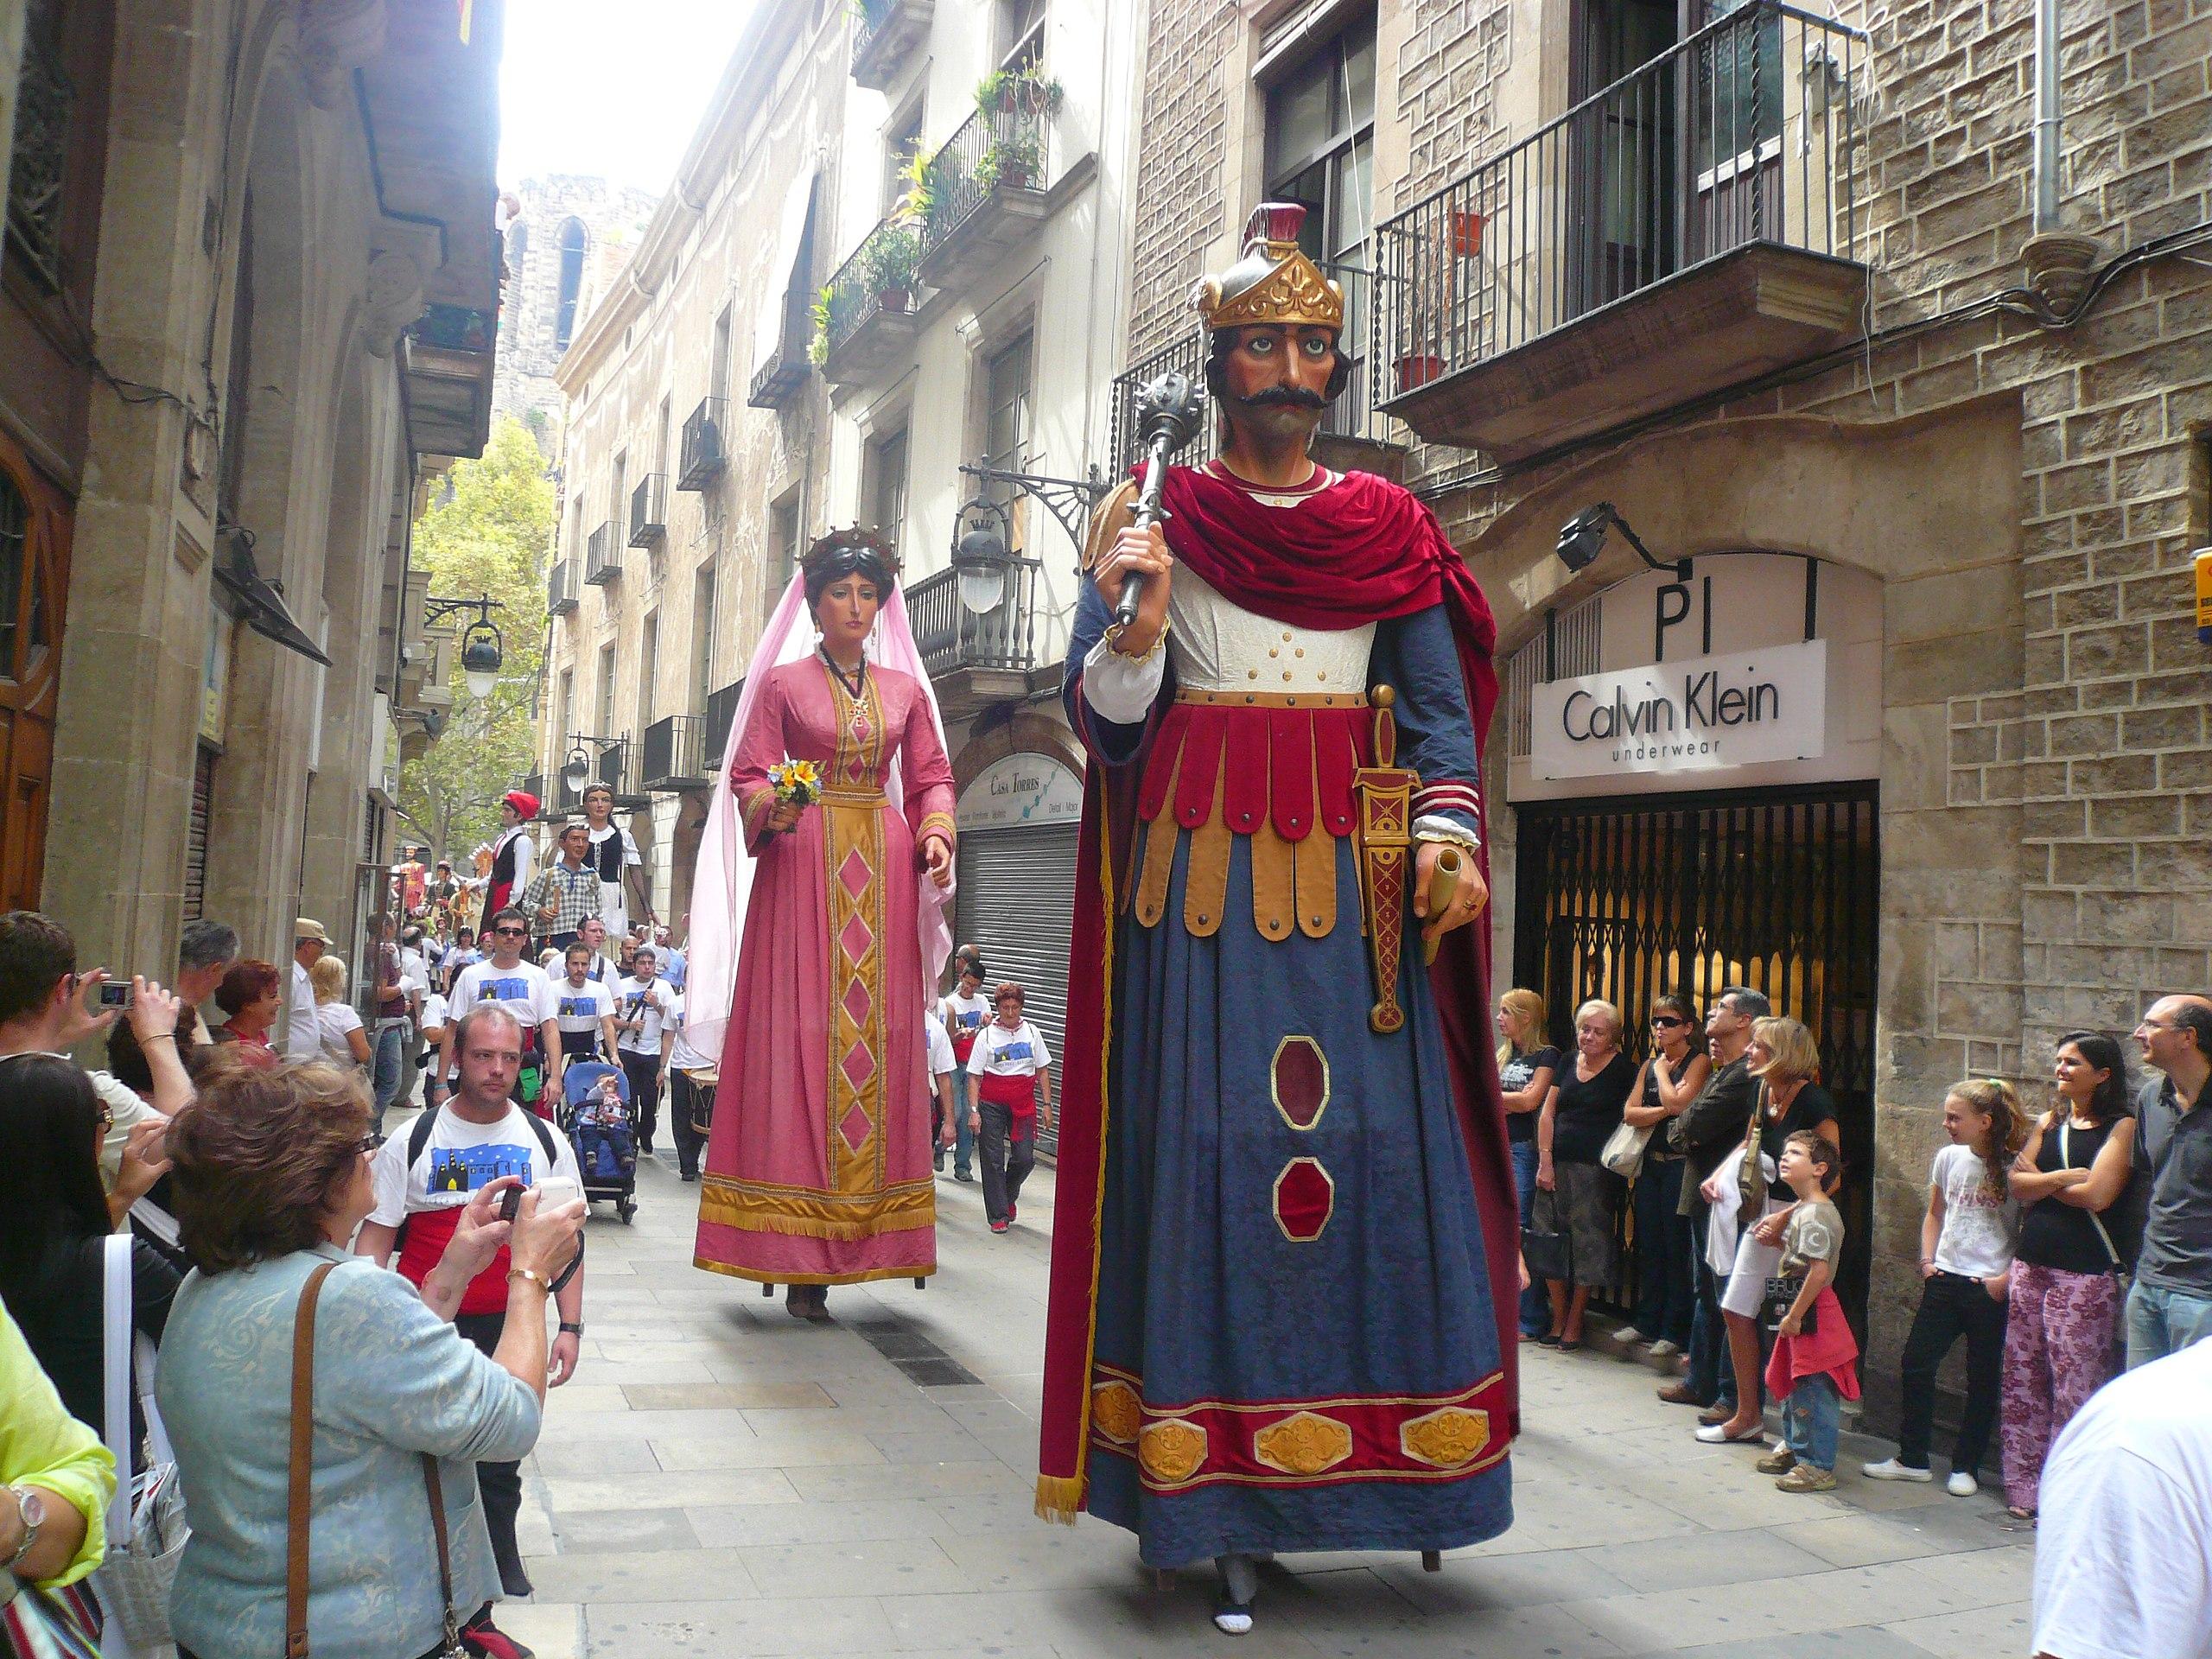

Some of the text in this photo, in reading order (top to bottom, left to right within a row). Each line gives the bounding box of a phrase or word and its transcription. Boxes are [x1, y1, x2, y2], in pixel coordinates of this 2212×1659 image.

[1562, 665, 1779, 742] Calvin Klein
[1612, 739, 1720, 762] underwear
[1012, 772, 1039, 793] TORRES
